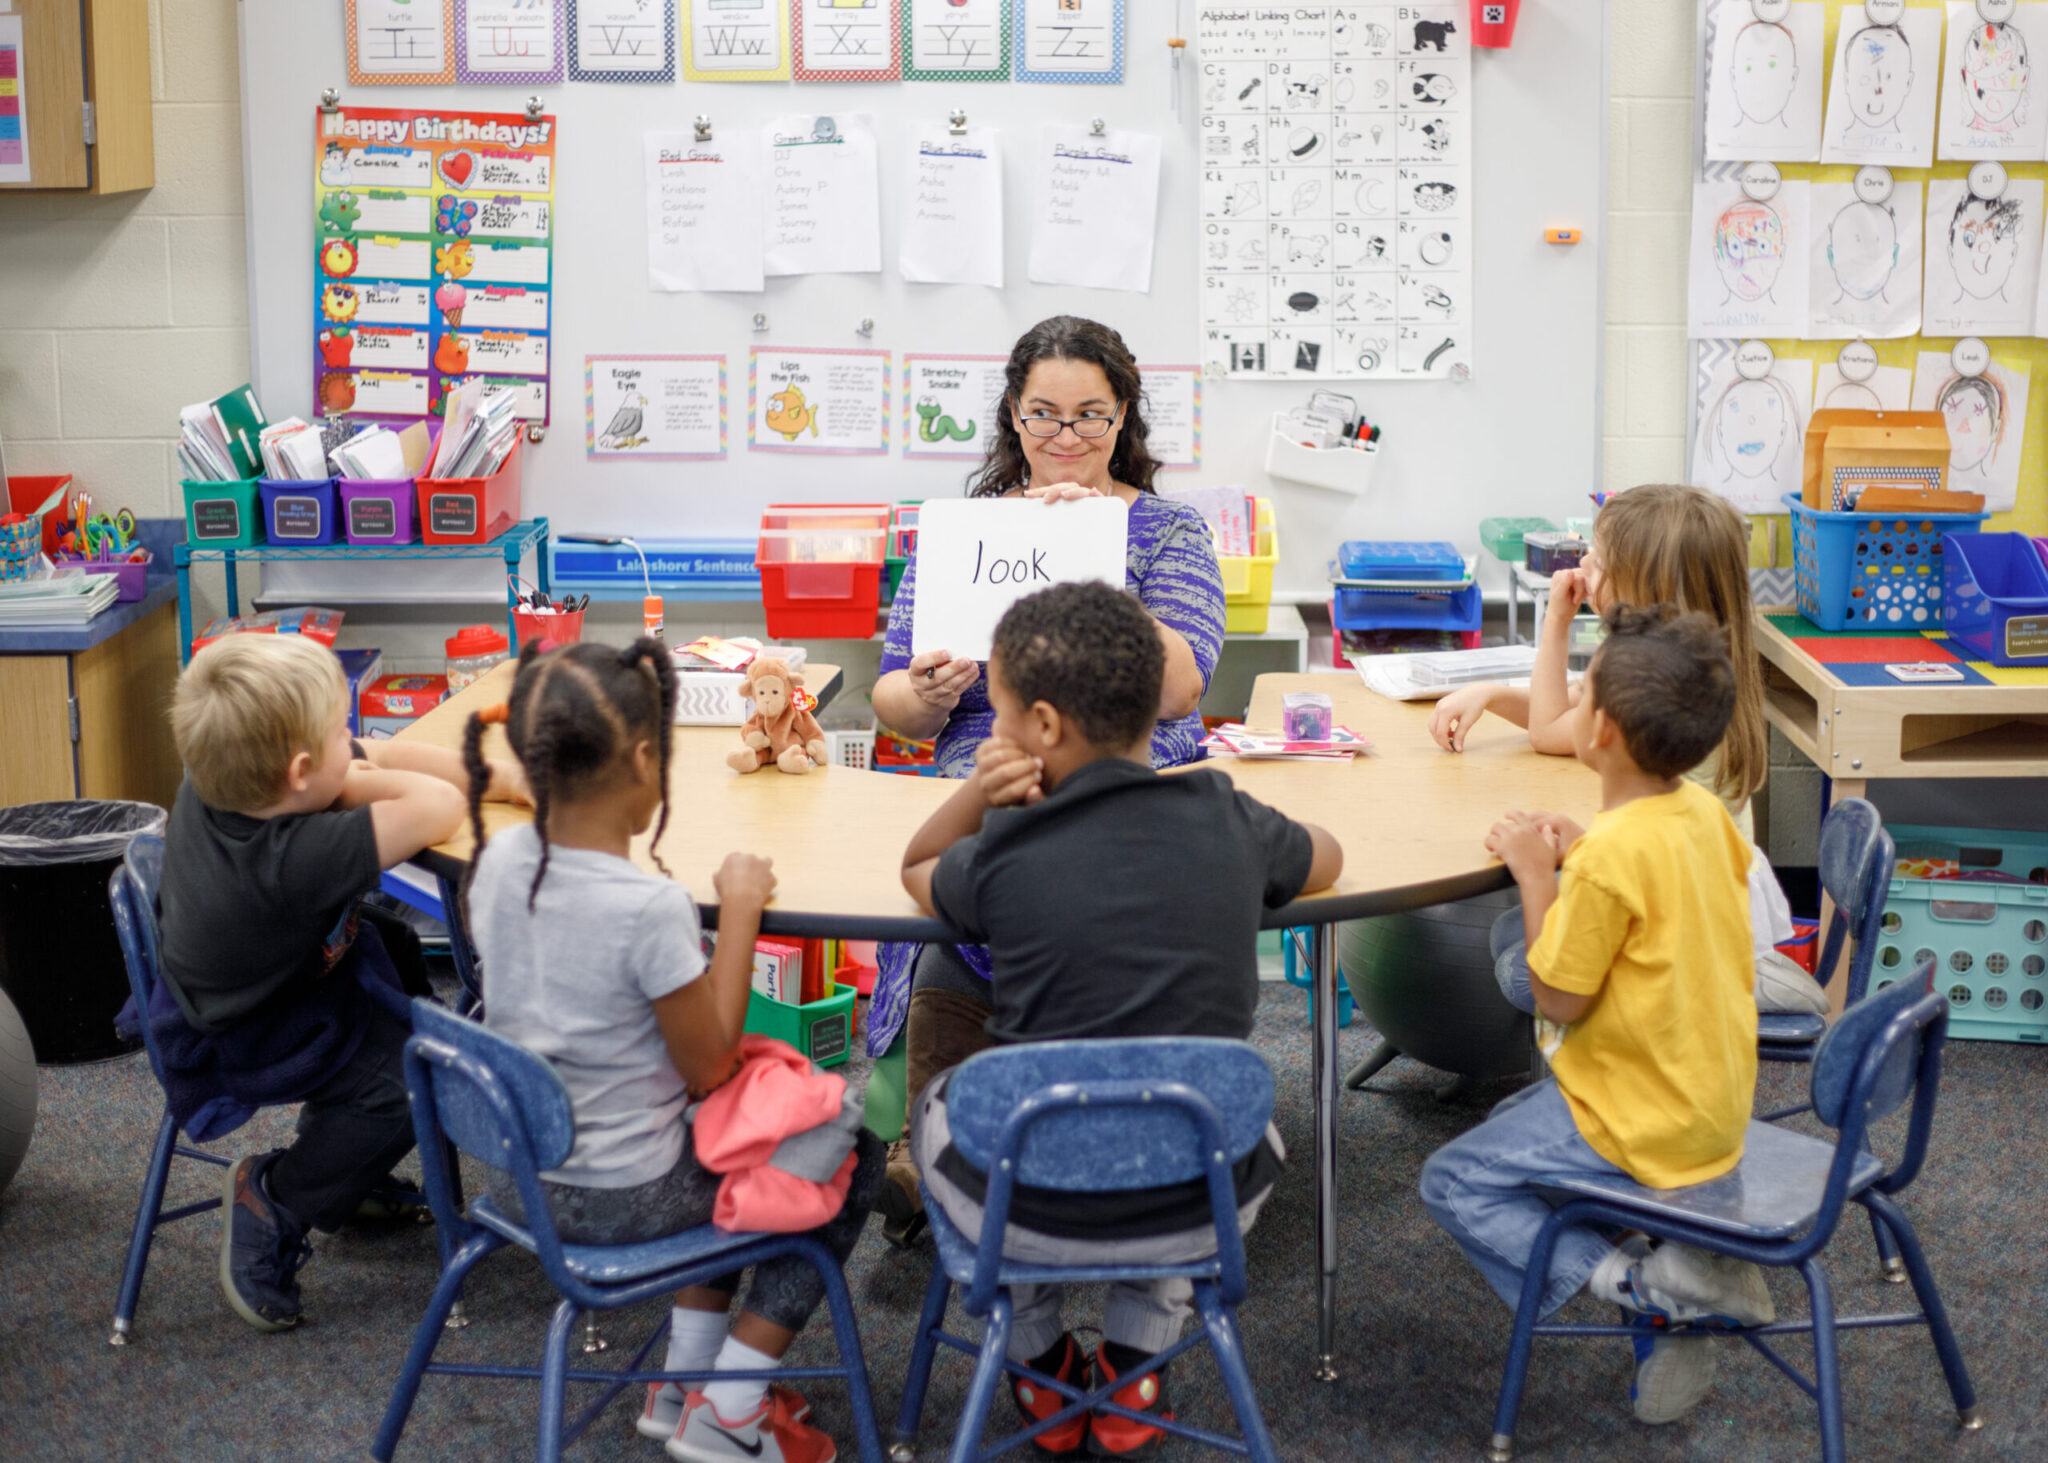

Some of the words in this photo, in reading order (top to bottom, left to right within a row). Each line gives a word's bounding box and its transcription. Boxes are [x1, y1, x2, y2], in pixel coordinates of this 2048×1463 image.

[1200, 10, 1250, 25] Alphabet
[1255, 10, 1289, 24] Linking
[1294, 9, 1325, 20] Chart
[324, 112, 410, 144] Happy
[412, 116, 552, 148] Birthdays!
[364, 144, 413, 157] January
[660, 149, 681, 161] Red
[688, 149, 720, 164] Group
[492, 241, 521, 251] June
[780, 361, 800, 372] Lips
[612, 369, 641, 380] Eagle
[771, 373, 789, 382] the
[790, 374, 810, 384] Fish
[921, 368, 968, 380] Stretchy
[618, 381, 636, 392] Eye
[928, 380, 960, 389] Snake
[973, 540, 1050, 584] look
[766, 963, 776, 1000] Party
